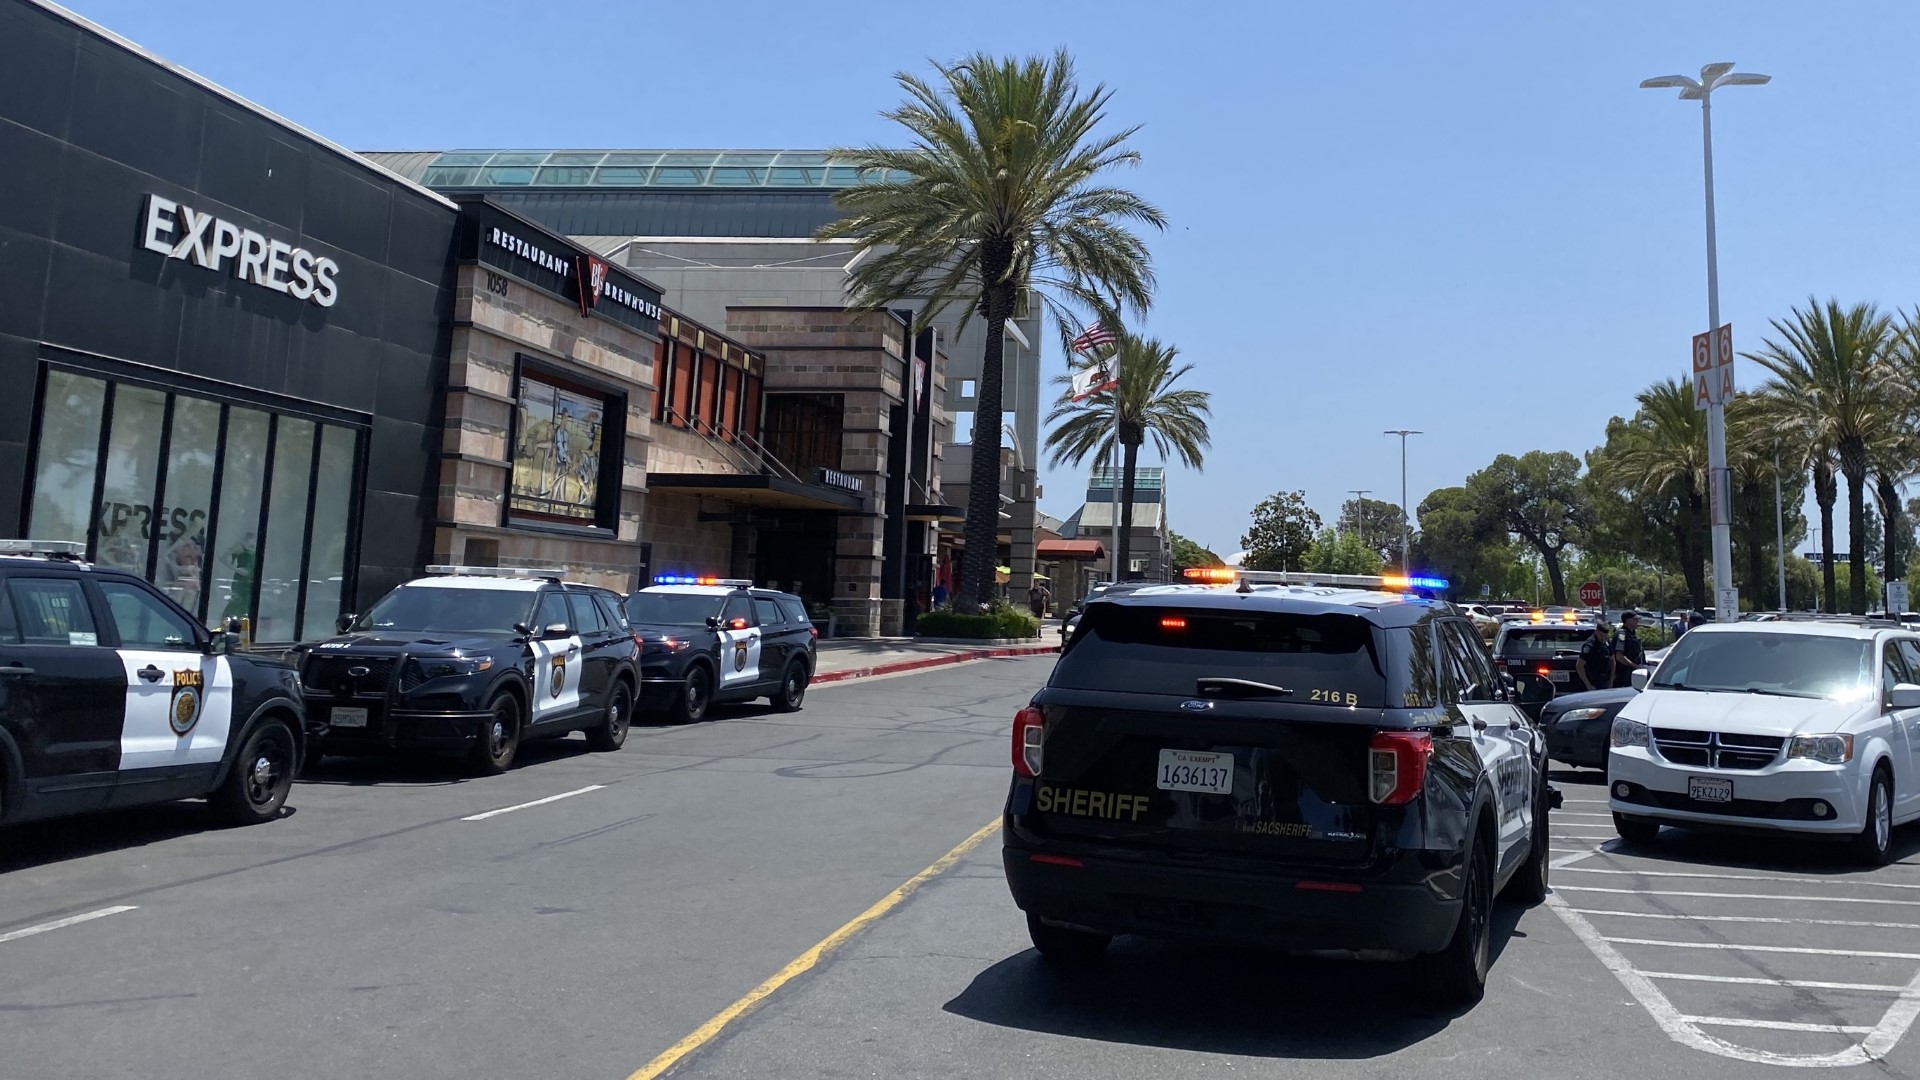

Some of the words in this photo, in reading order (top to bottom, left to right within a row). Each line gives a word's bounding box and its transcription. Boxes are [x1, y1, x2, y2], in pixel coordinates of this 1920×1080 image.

[145, 194, 340, 307] EXPRESS
[486, 270, 508, 297] 1058
[493, 227, 569, 277] RESTAURANT
[604, 280, 662, 321] BREWHOUSE
[1696, 336, 1708, 369] 6
[1721, 328, 1730, 361] 6
[1697, 375, 1711, 406] A
[1722, 368, 1733, 401] A
[825, 469, 863, 491] RESTAURANT
[176, 672, 202, 686] POLICE
[1311, 689, 1341, 703] 216
[1346, 692, 1358, 705] B
[1190, 756, 1216, 764] EXEMPT
[1162, 765, 1228, 788] 1636137
[1037, 786, 1149, 822] SHERIFF
[1692, 785, 1730, 799] 9EKZ129
